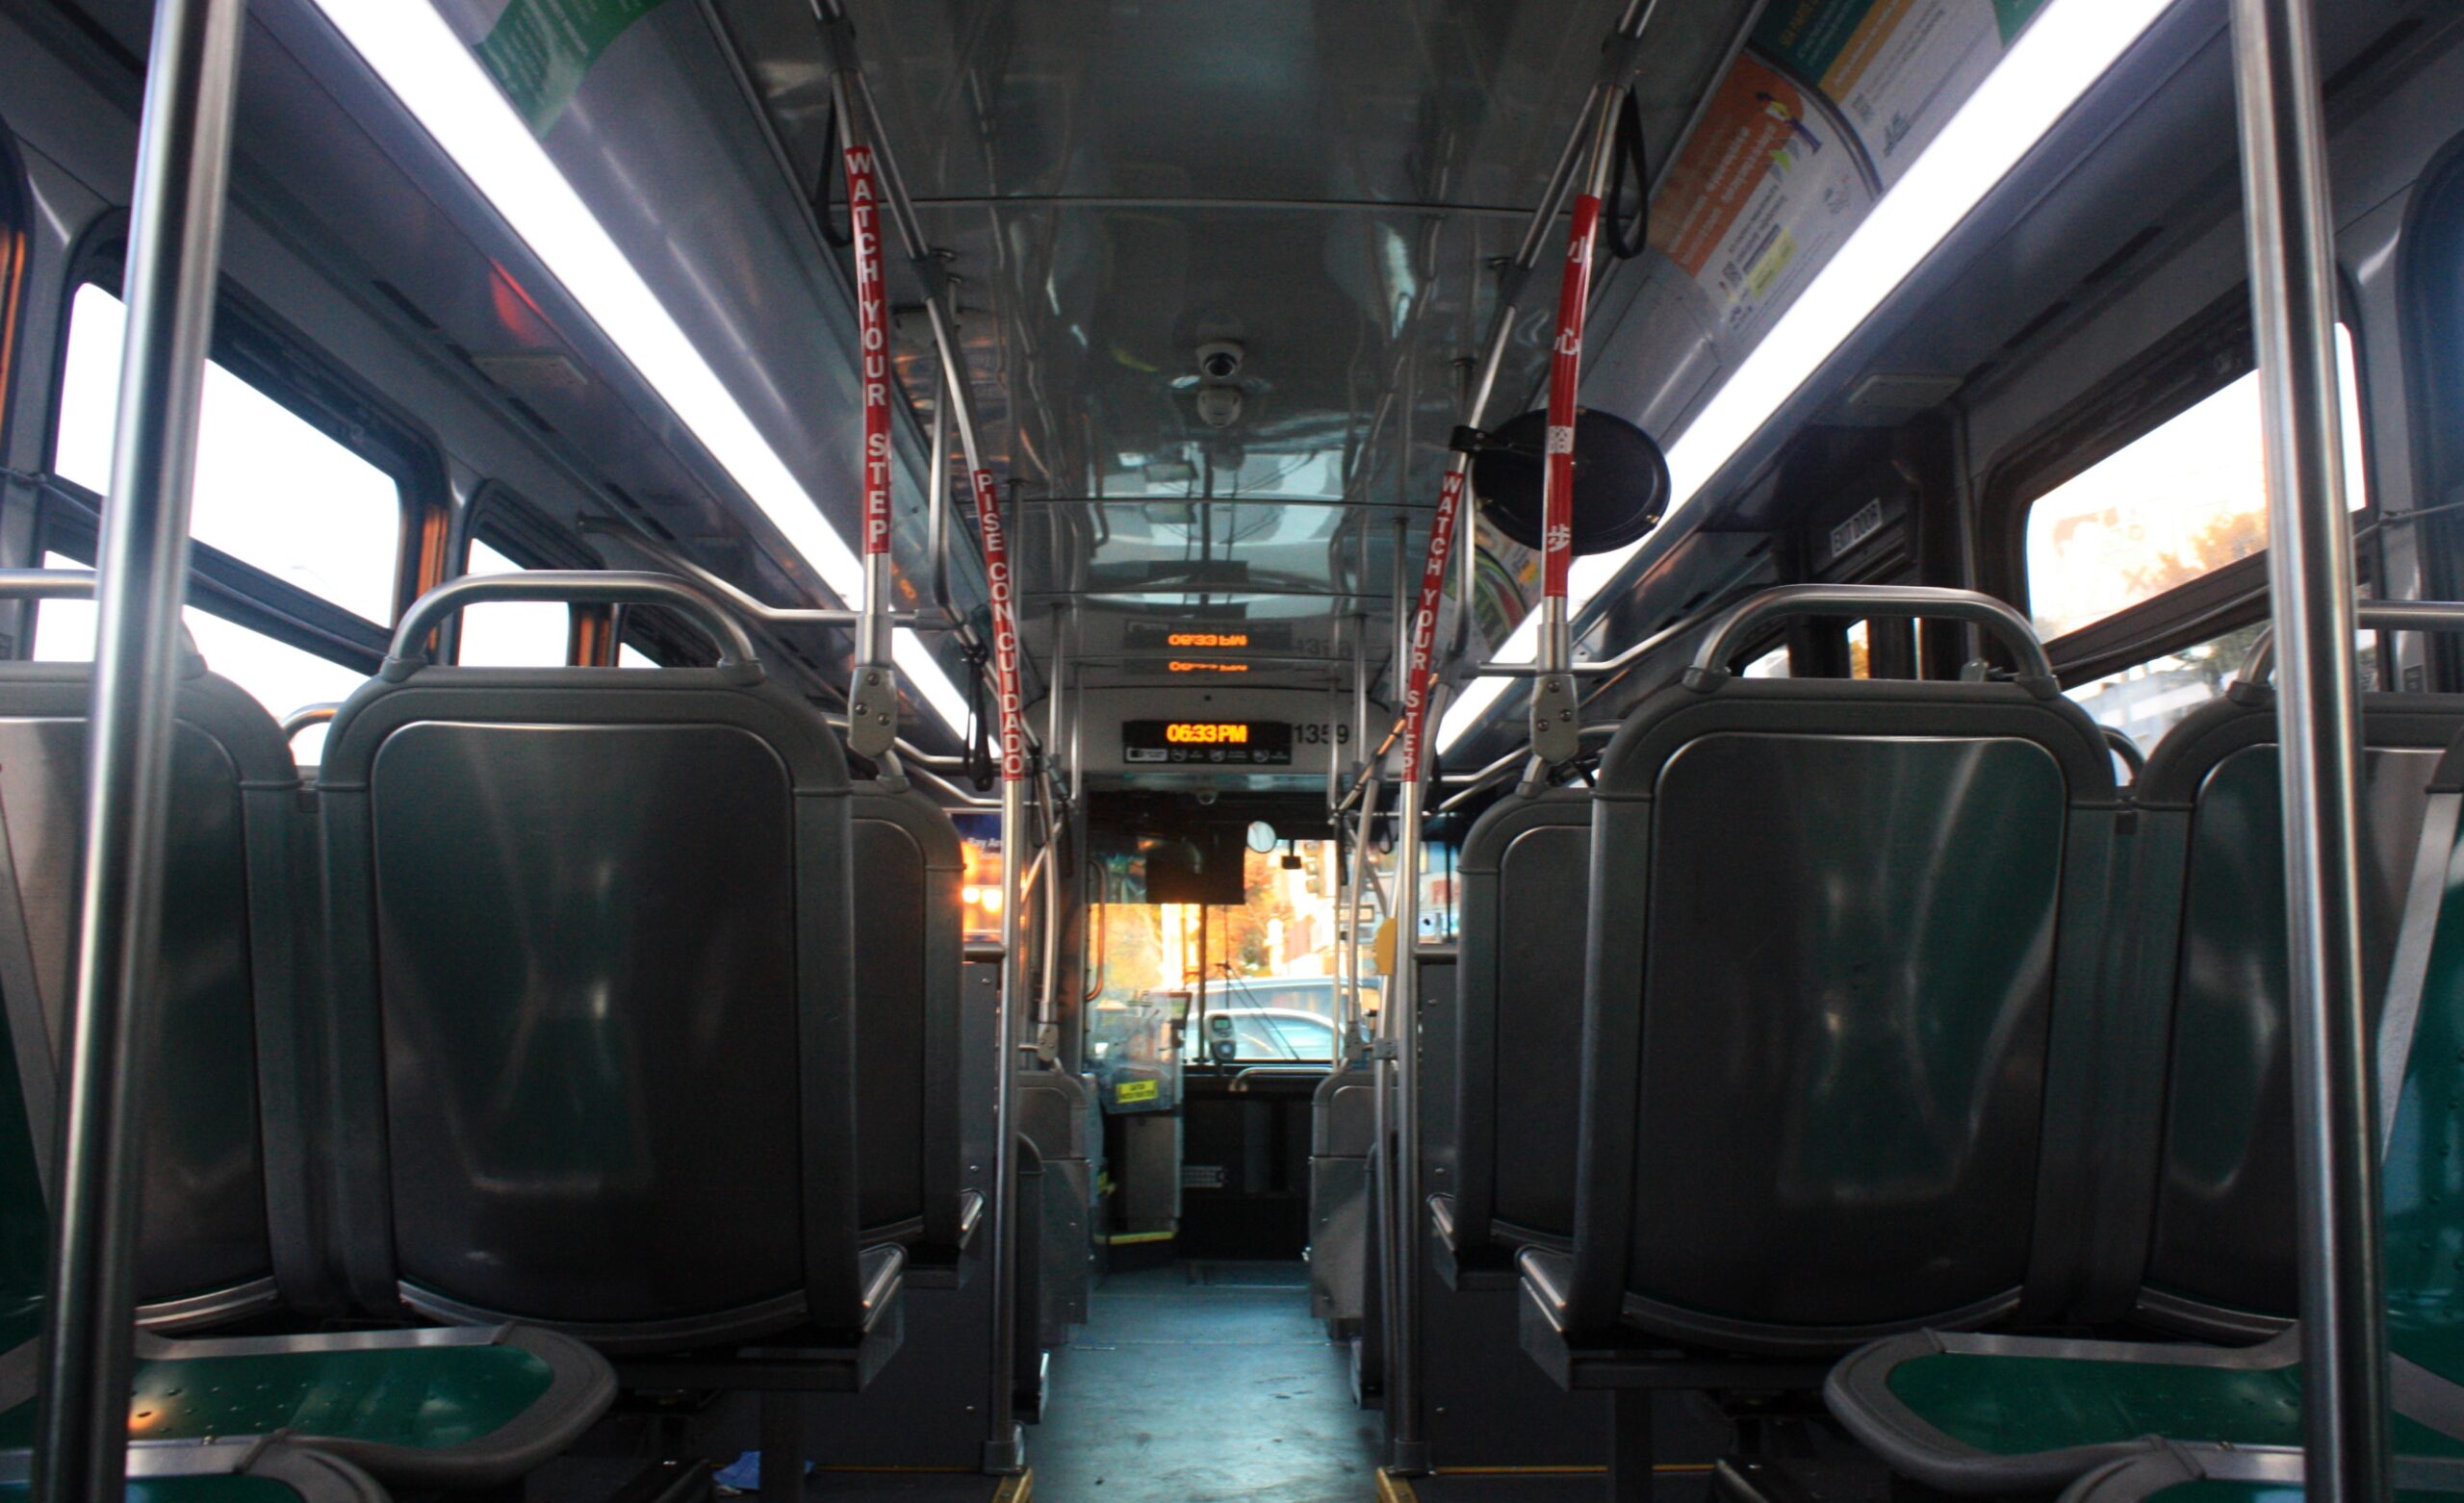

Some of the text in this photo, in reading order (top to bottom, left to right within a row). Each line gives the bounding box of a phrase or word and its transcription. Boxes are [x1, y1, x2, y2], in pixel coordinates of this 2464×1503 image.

[845, 152, 888, 544] WATCH YOUR STEP
[977, 473, 1023, 775] PISE CON CUIDADO
[1218, 724, 1248, 743] PM
[1401, 475, 1462, 776] WATCH YOUR STEP
